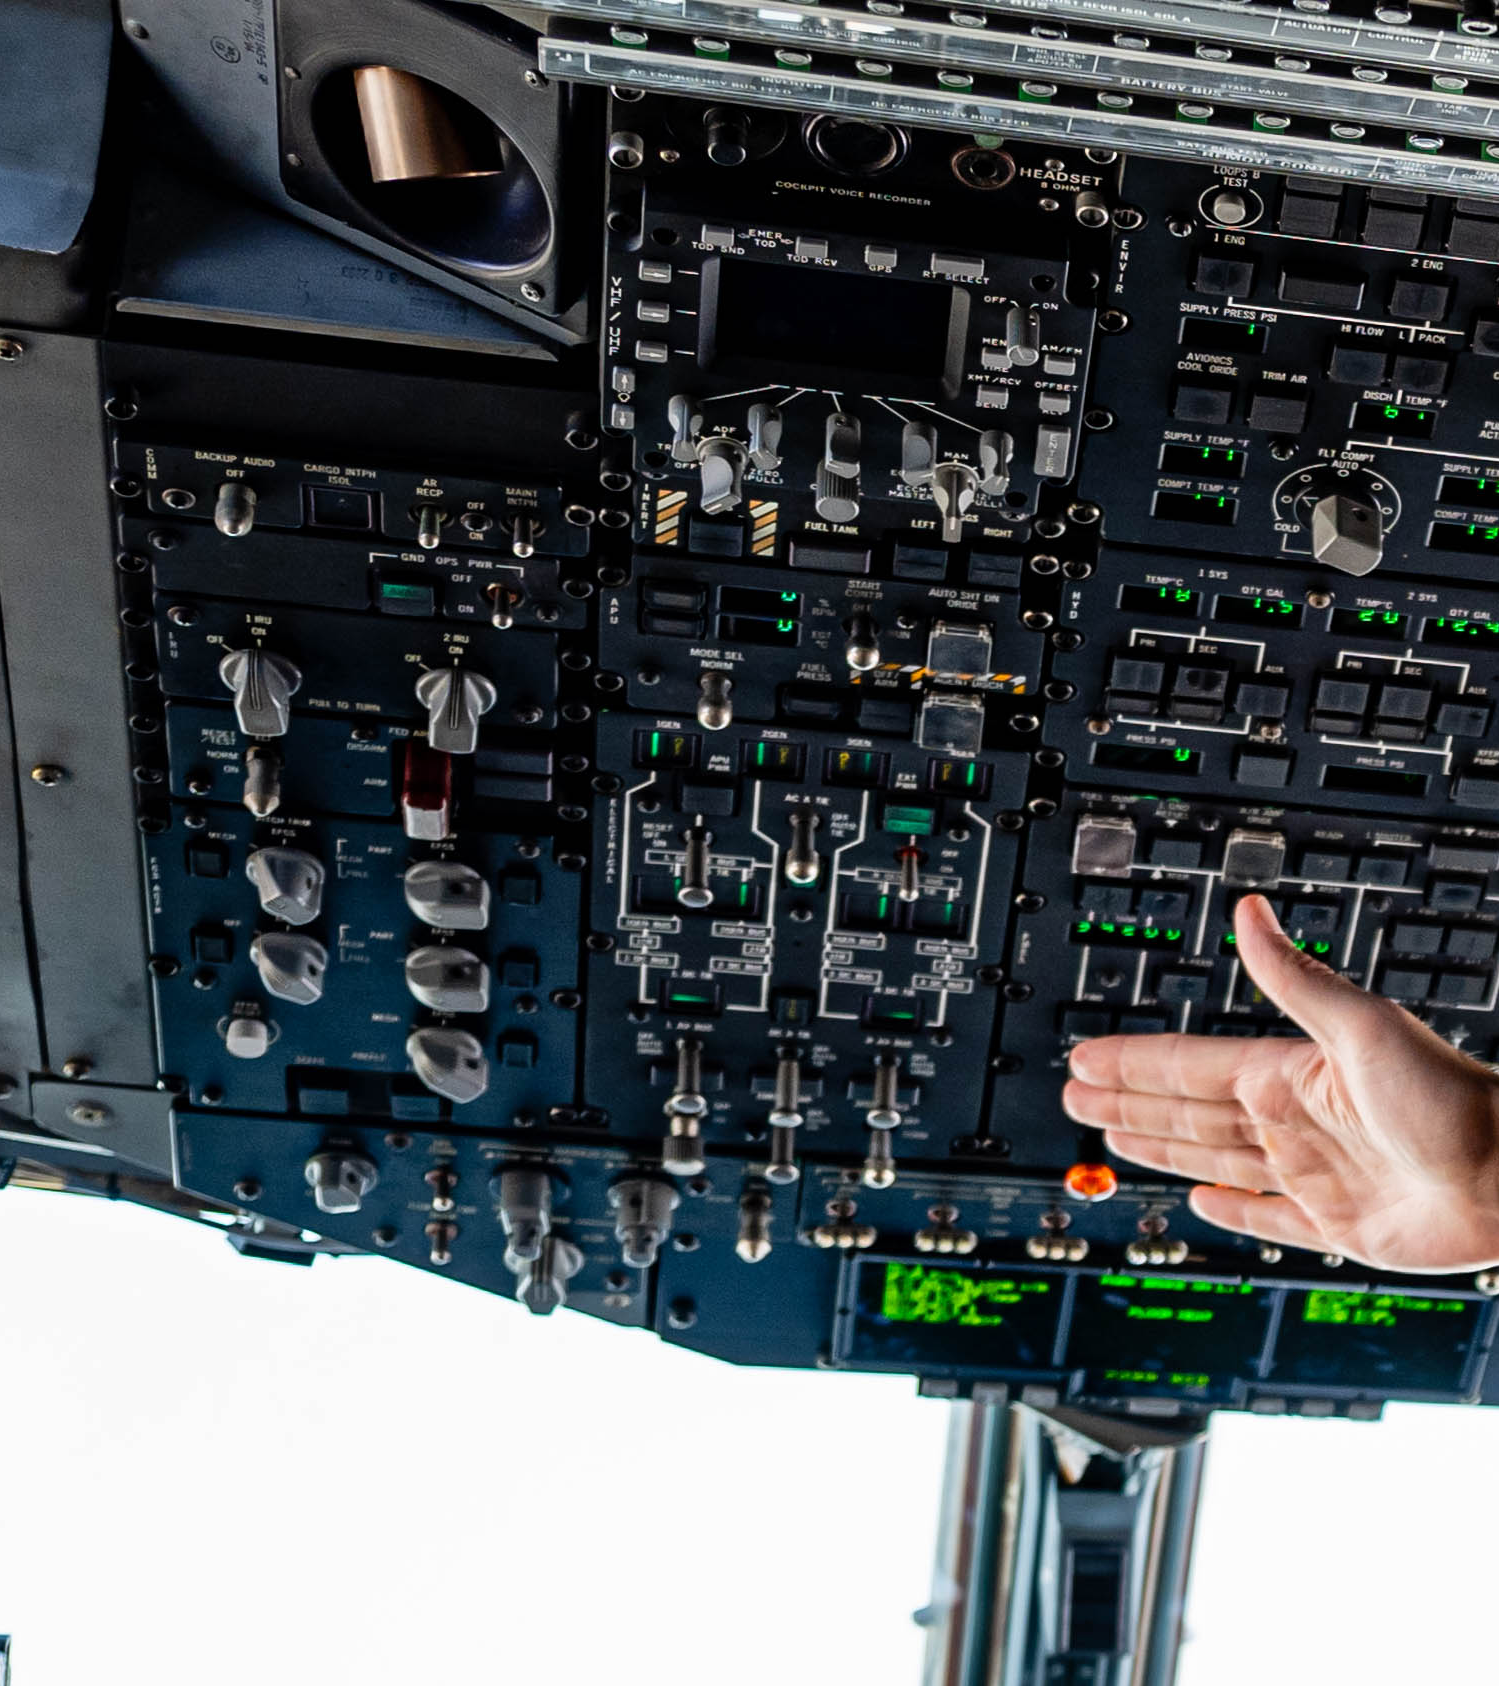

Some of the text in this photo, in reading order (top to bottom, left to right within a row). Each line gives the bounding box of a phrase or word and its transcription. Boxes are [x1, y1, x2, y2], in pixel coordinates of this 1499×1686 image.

[1019, 167, 1103, 188] HEADSET
[1213, 165, 1248, 178] LOOPS
[1053, 183, 1081, 193] OHM
[1223, 176, 1249, 188] TEST
[775, 180, 931, 206] COCKPIT VOICE RECORDER
[748, 228, 783, 240] EMER
[1224, 234, 1246, 246] ENG
[692, 241, 745, 256] TOD SND
[754, 239, 777, 249] TOD
[786, 253, 838, 267] TOD RCV
[1411, 258, 1445, 271] 2 ENG
[868, 264, 893, 274] GPS
[1115, 239, 1130, 294] ENVIR
[945, 272, 990, 285] SELECT
[984, 295, 1007, 304] OFF
[1042, 302, 1059, 311] ON
[1180, 302, 1277, 323] SUPPLY PRESS PSI
[1355, 325, 1385, 337] FLOW
[1419, 333, 1446, 344] PACK
[1041, 344, 1083, 356] AM/FM
[1186, 352, 1233, 366] AVIONICS
[1177, 361, 1203, 372] COOL
[1262, 370, 1308, 384] TRIM AIR
[1034, 380, 1080, 393] OFFSET
[1363, 390, 1432, 406] DISCH TEMP
[713, 425, 737, 434] ADF
[1163, 430, 1235, 446] SUPPLY TEMP
[195, 450, 276, 468] BACKUP AUDIO
[944, 451, 969, 460] MAN
[1318, 448, 1375, 463] FLT COMPT
[304, 463, 341, 476] CARGO
[674, 461, 697, 470] OFF
[1331, 459, 1359, 470] AUTO
[1443, 463, 1480, 476] SUPPLY
[226, 469, 245, 479] OFF
[328, 476, 351, 487] ISOL
[422, 478, 437, 488] AR
[1197, 482, 1224, 493] TEMP
[416, 487, 444, 498] RECP
[506, 487, 538, 498] MAINT
[888, 490, 934, 501] MASTER
[467, 501, 485, 511] OFF
[1434, 509, 1499, 525] COMPT TEMP
[804, 520, 859, 536] FUEL TANK
[911, 519, 937, 530] LEFT
[1274, 522, 1301, 533] COLD
[469, 531, 484, 541] ON
[983, 527, 1014, 539] RIGHT
[401, 552, 493, 570] GND OPS PWR
[451, 573, 473, 584] OFF
[1208, 569, 1229, 581] SYS
[928, 588, 982, 601] AUTO SHT
[1418, 593, 1438, 603] SYS
[458, 604, 475, 614] ON
[690, 648, 745, 662] MODE SEL
[701, 660, 734, 671] NORM
